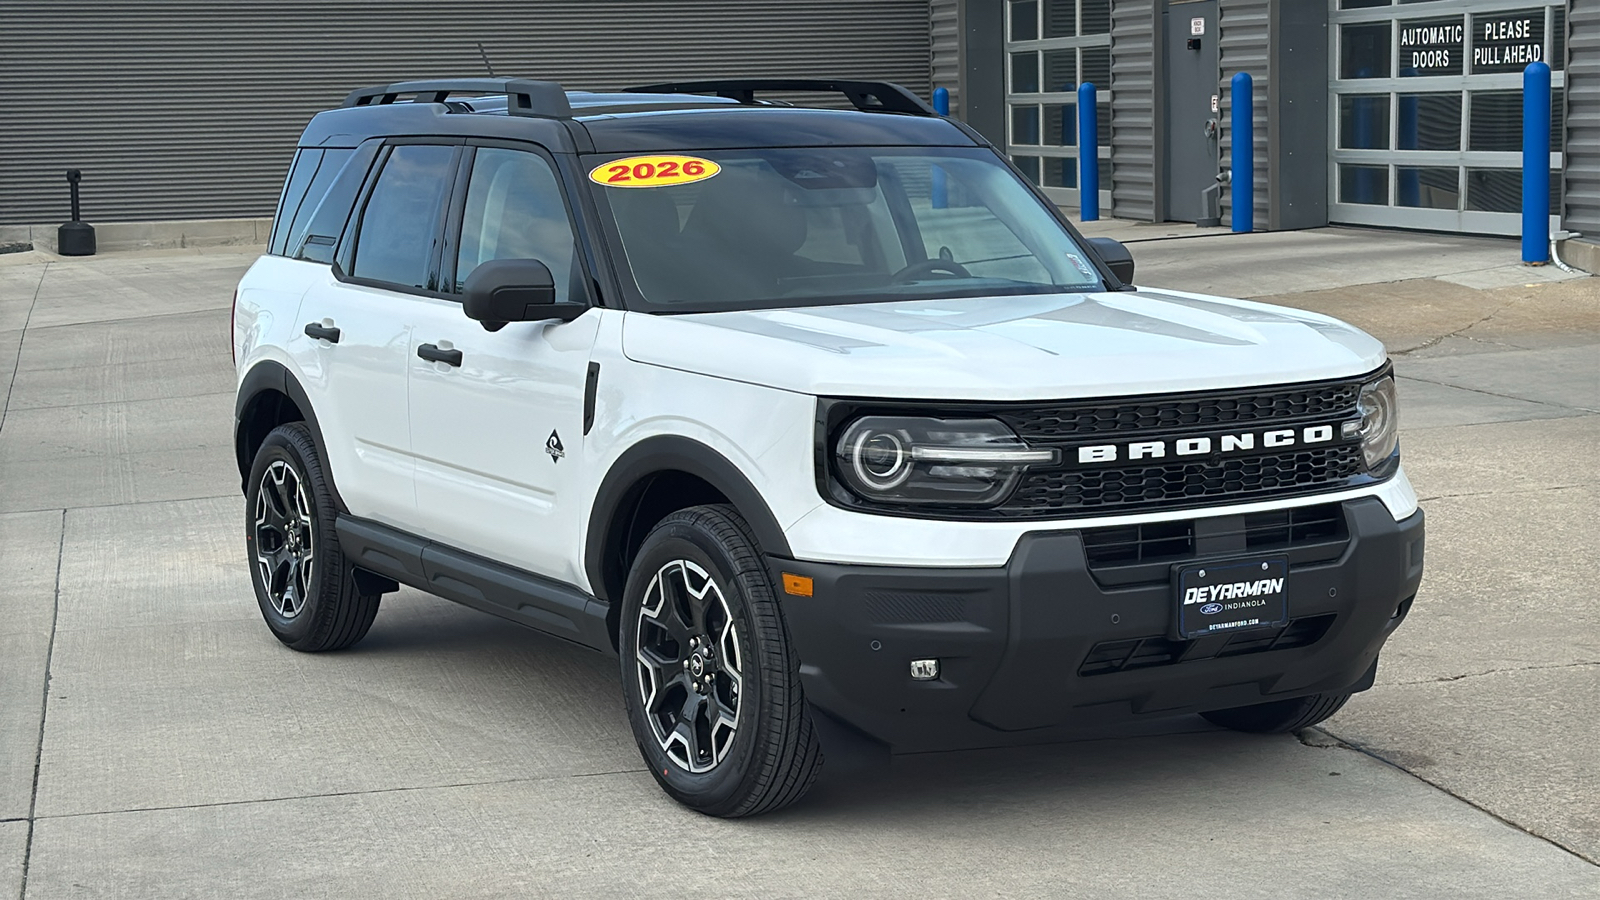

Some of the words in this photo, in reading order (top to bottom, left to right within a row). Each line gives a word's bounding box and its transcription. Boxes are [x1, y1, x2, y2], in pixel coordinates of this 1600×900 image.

[1401, 25, 1462, 46] AUTOMATIC
[1485, 20, 1531, 40] PLEASE
[1412, 49, 1449, 68] DOORS
[1474, 46, 1500, 66] PULL
[1503, 44, 1541, 64] AHEAD
[607, 160, 706, 183] 2026
[1078, 425, 1333, 464] BRONCO
[1184, 578, 1284, 605] DEYARMAN
[1224, 599, 1266, 611] INDIANOLA
[1209, 619, 1259, 630] DEYARMANFORD.COM
